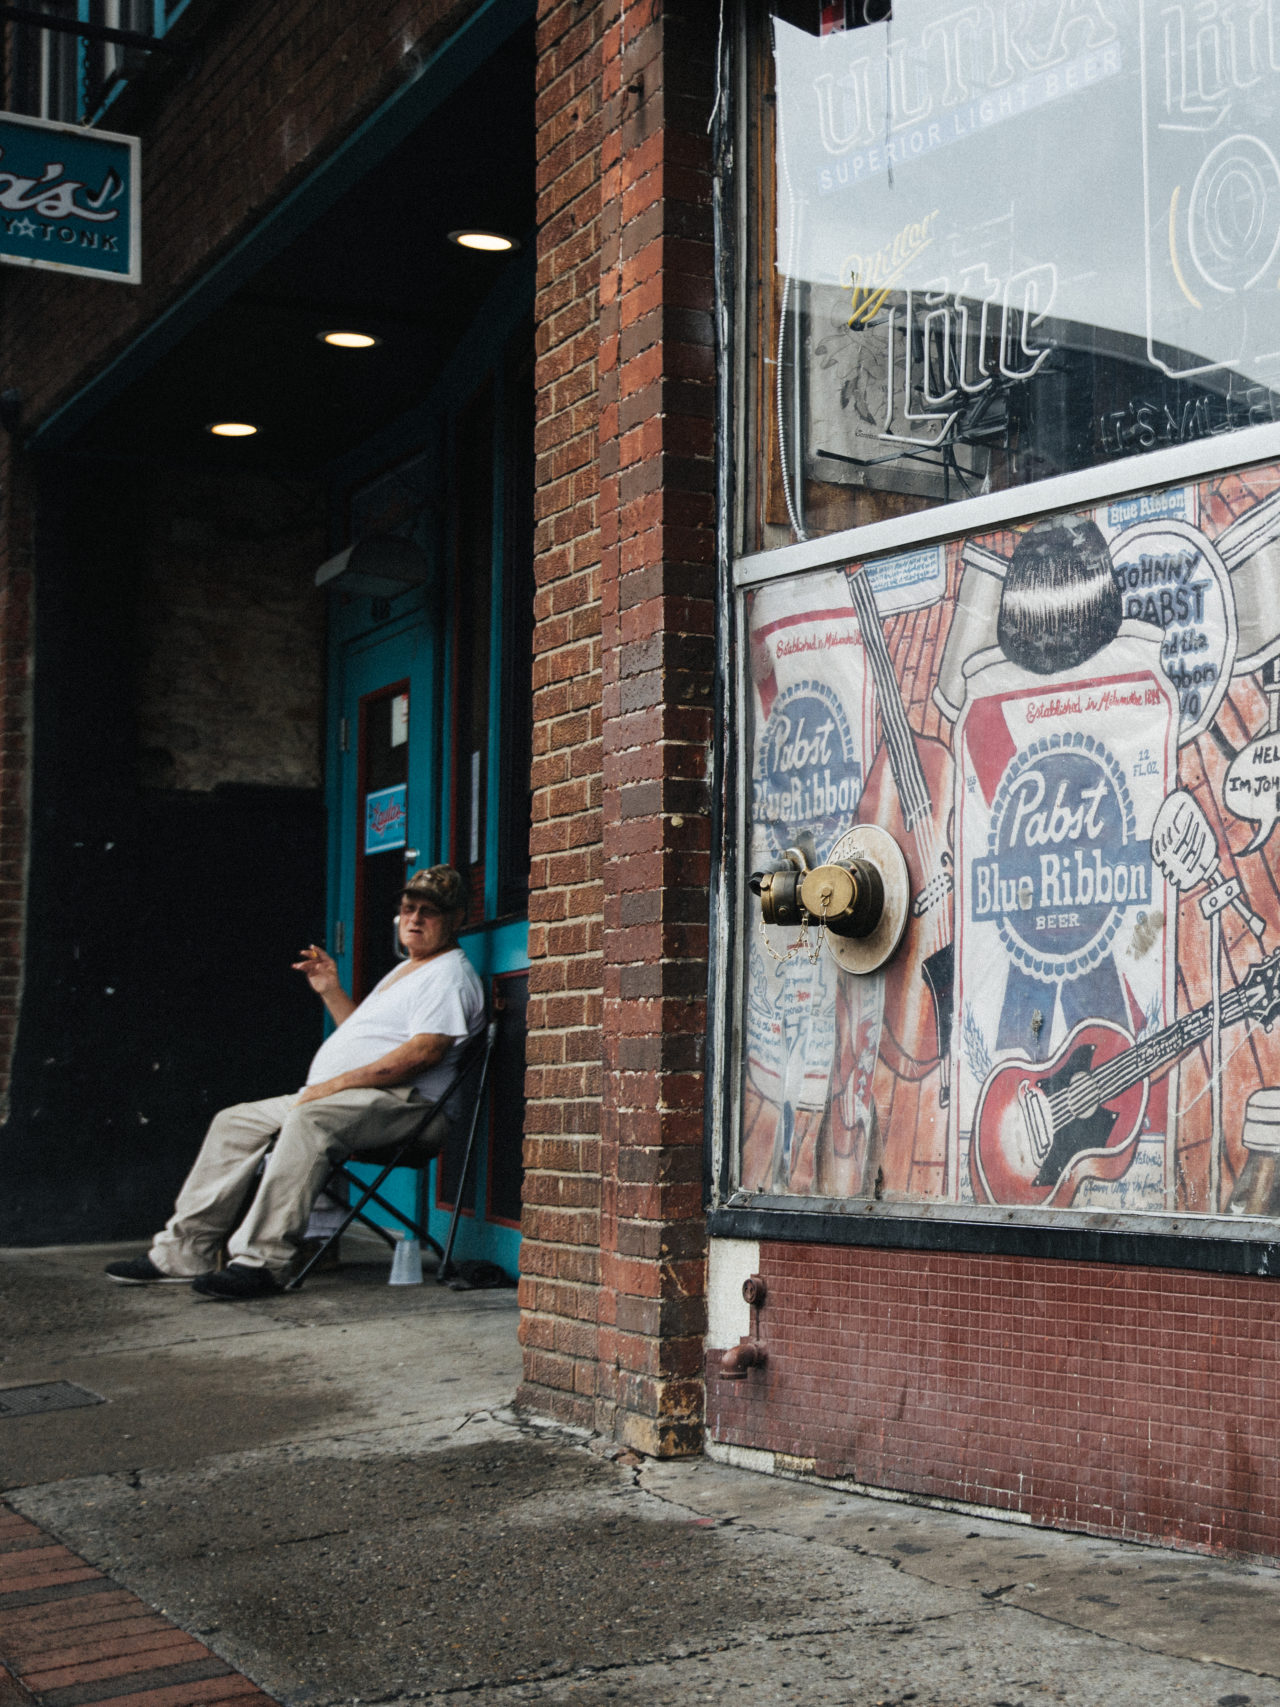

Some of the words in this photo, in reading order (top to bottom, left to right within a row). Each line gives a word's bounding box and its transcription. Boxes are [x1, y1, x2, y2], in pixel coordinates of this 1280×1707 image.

[820, 122, 942, 190] SUPERIOR
[954, 85, 1029, 136] LIGHT
[1045, 49, 1121, 97] BEER
[1115, 550, 1203, 594] JOHNNY
[770, 706, 835, 774] Pabst
[789, 769, 861, 820] Ribbon
[1008, 770, 1109, 847] Pabst
[975, 863, 1034, 915] Blue
[1039, 849, 1148, 908] Ribbon
[1035, 913, 1081, 930] BEER
